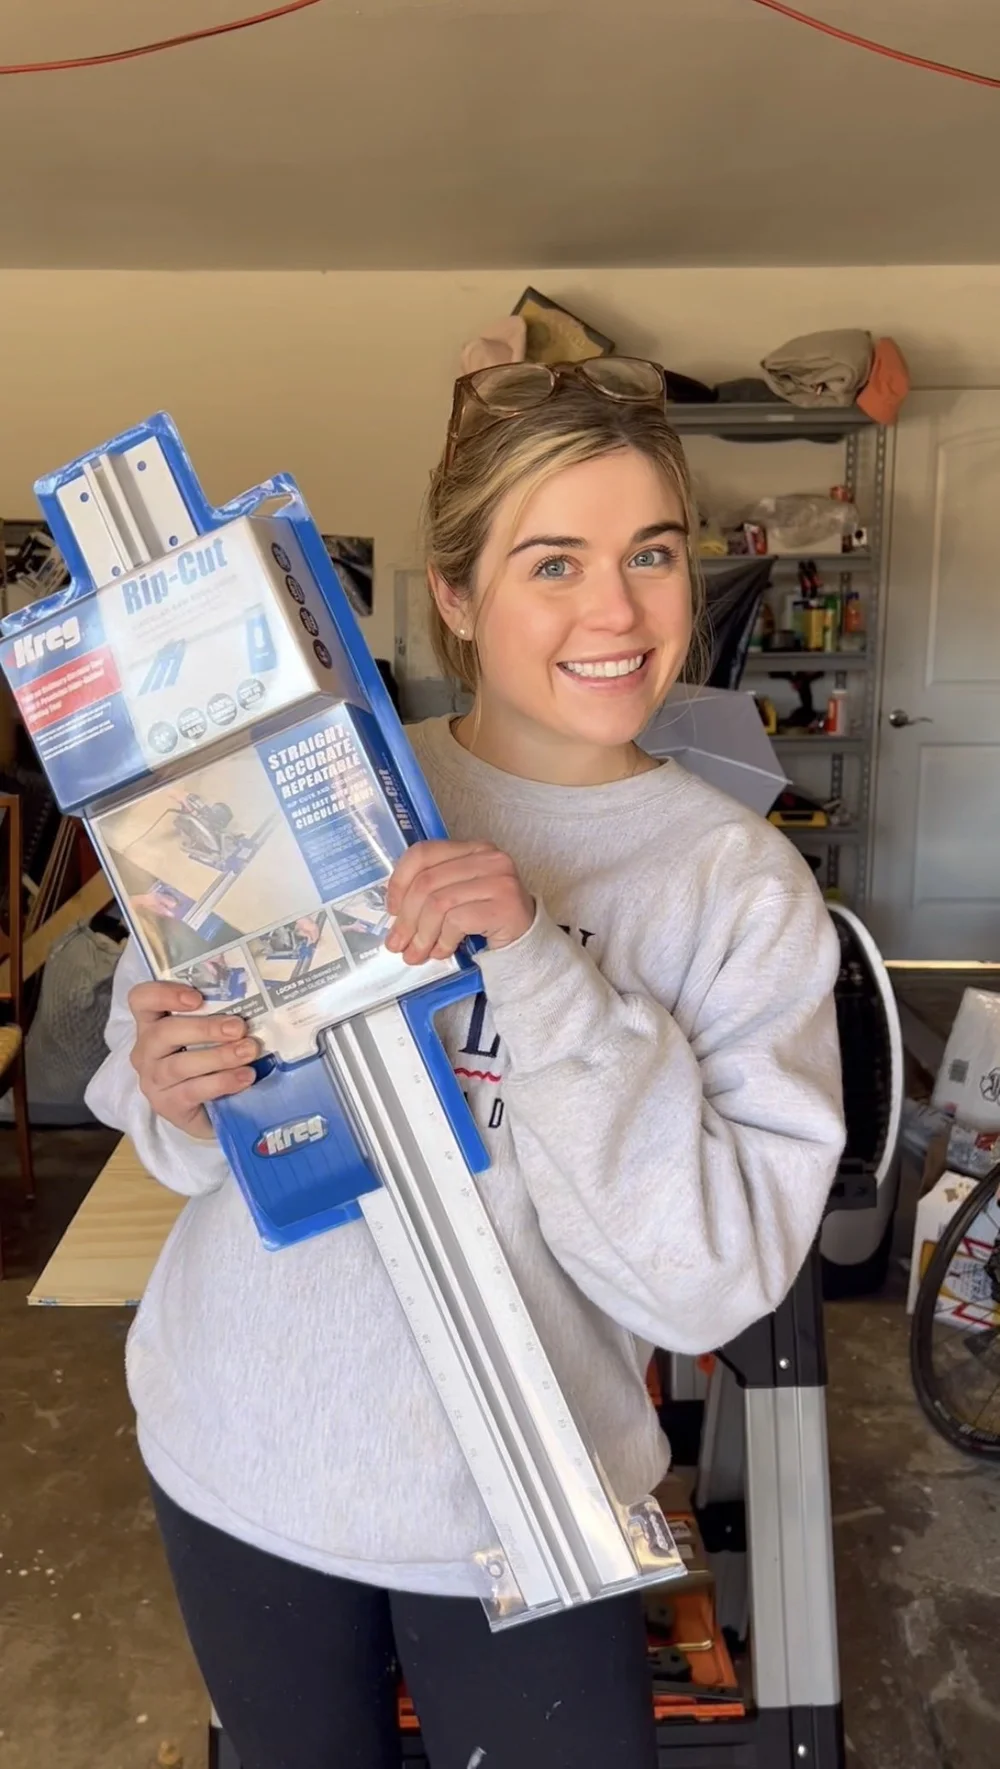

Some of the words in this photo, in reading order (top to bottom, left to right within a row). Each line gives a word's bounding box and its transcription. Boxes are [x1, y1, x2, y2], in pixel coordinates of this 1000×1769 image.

[121, 537, 228, 616] Rip-Cut
[13, 615, 81, 669] Kreg
[268, 723, 350, 770] STRAIGHT.
[275, 737, 356, 785] ACCURATE.
[281, 752, 361, 800] REPEATABLE
[295, 799, 346, 830] CIRCULAR
[266, 1115, 324, 1156] Kreg
